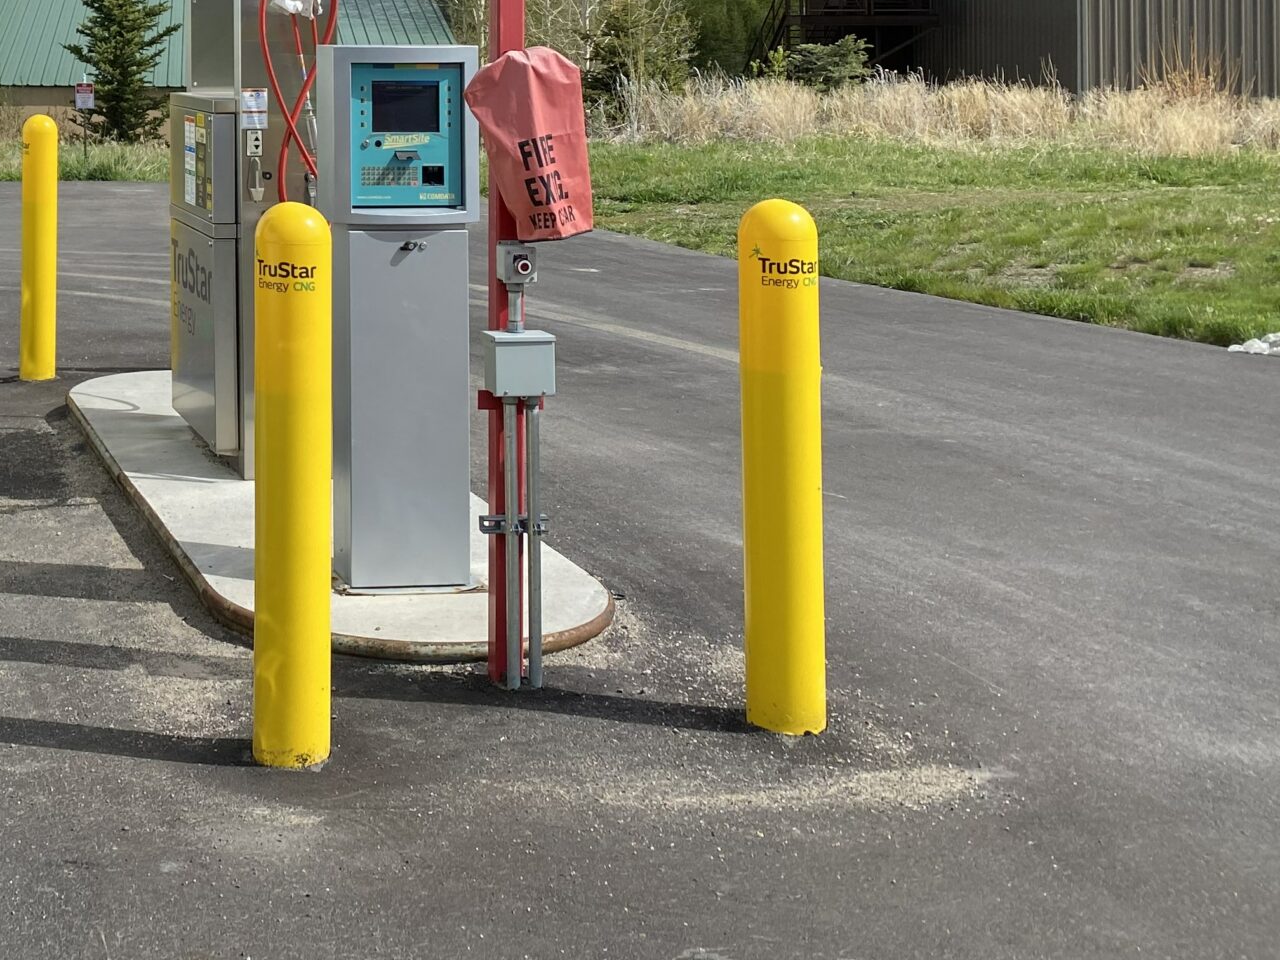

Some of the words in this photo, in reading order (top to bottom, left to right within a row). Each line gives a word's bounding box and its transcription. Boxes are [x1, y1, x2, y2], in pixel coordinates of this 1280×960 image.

[384, 133, 430, 144] SmartSite
[171, 238, 212, 304] TruStar
[257, 259, 317, 279] TruStar
[258, 277, 290, 293] Energy
[293, 281, 316, 291] CNG
[761, 275, 800, 289] Energy
[173, 291, 196, 336] Energy
